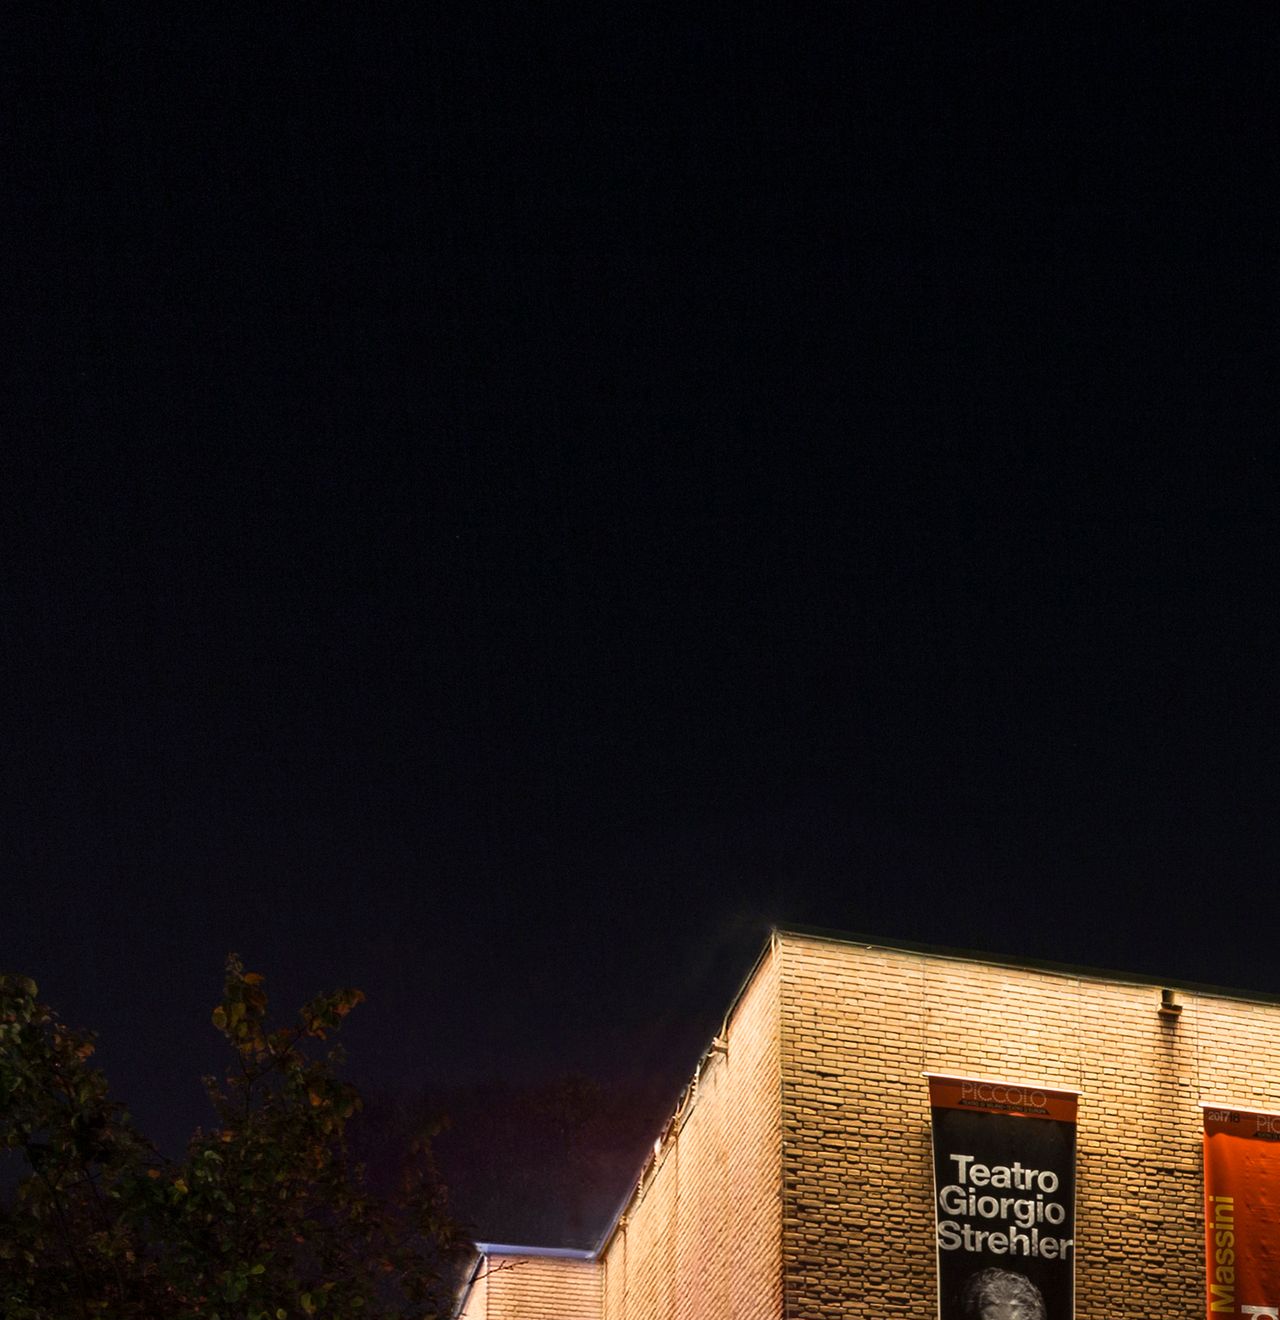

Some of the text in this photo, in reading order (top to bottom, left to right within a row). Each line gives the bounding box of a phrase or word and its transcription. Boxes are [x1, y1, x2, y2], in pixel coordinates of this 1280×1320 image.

[961, 1082, 1047, 1108] PICCOLO
[950, 1154, 1059, 1193] Teatro
[939, 1184, 1066, 1229] Giorgio
[938, 1220, 1074, 1260] Strehler
[1209, 1195, 1236, 1313] Massini
